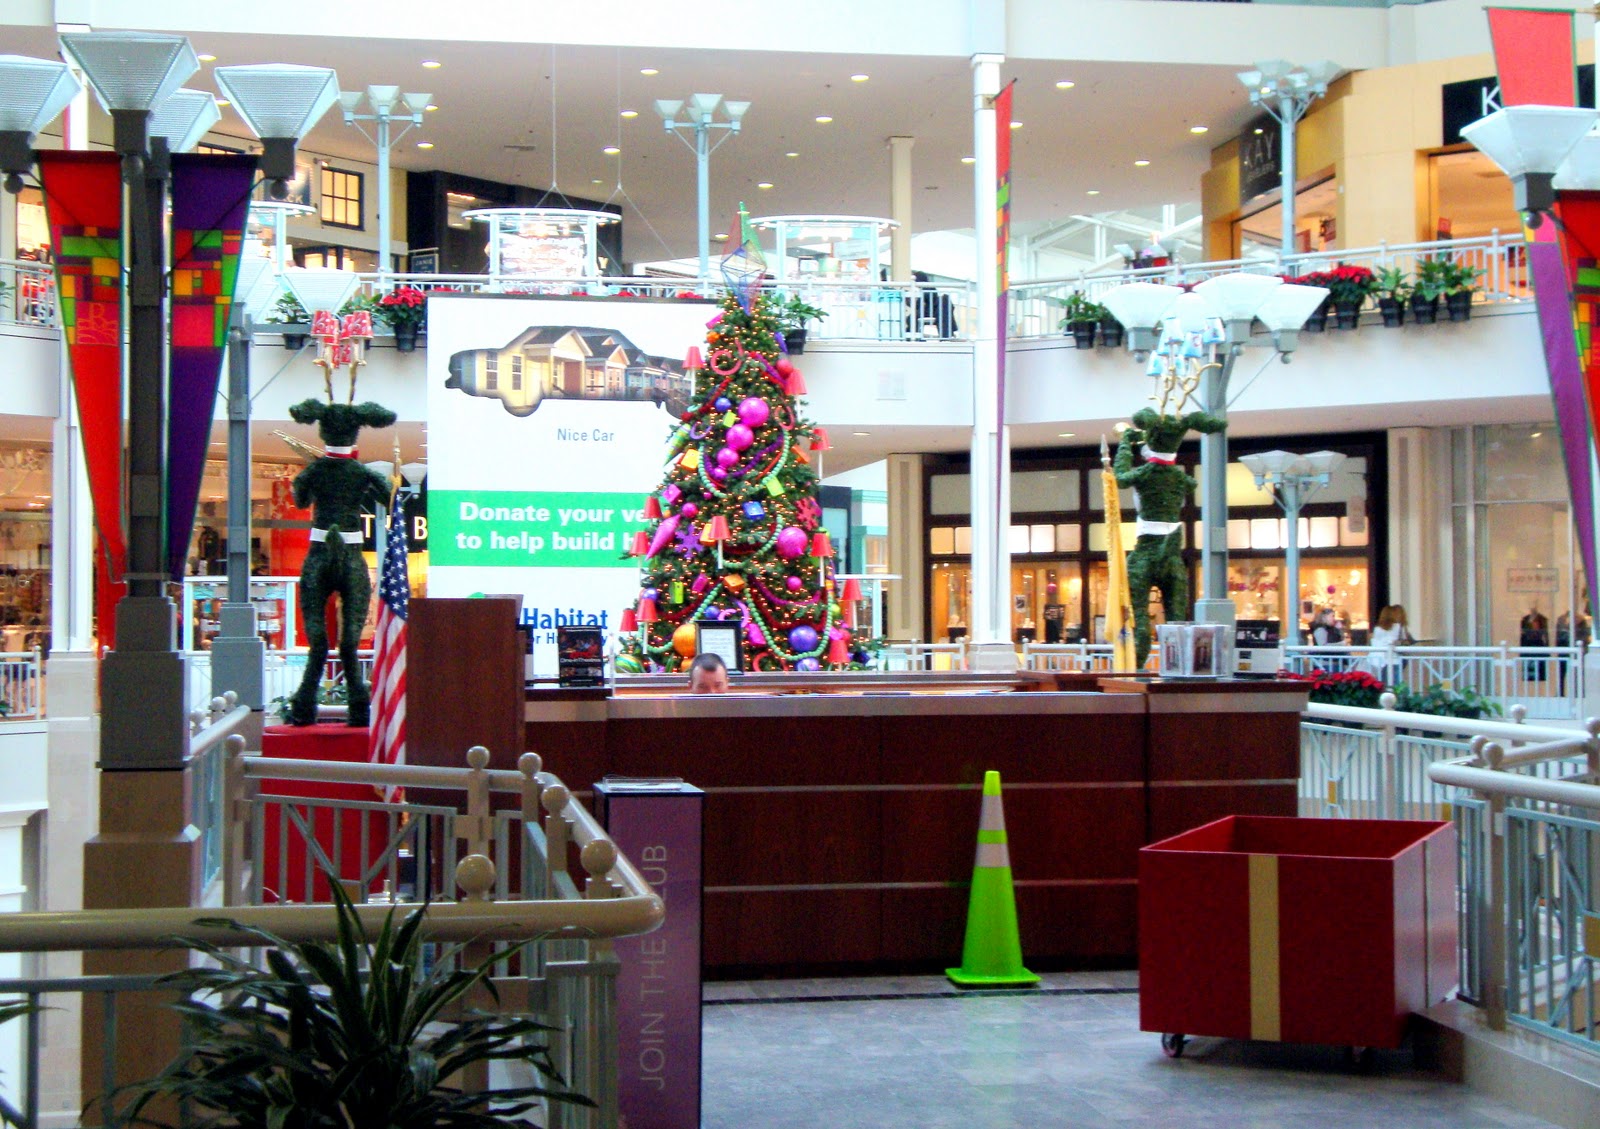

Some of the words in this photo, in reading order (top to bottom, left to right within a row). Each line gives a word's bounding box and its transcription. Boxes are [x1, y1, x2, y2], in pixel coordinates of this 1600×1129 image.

[557, 428, 588, 441] Nice
[592, 428, 614, 441] Car
[459, 501, 550, 522] Donate
[558, 508, 614, 527] your
[621, 508, 648, 522] ve
[456, 532, 482, 549] to
[490, 531, 545, 554] help
[552, 532, 615, 550] build
[523, 608, 608, 629] Habitat
[641, 937, 667, 1002] THE
[640, 1013, 666, 1091] JOIN
